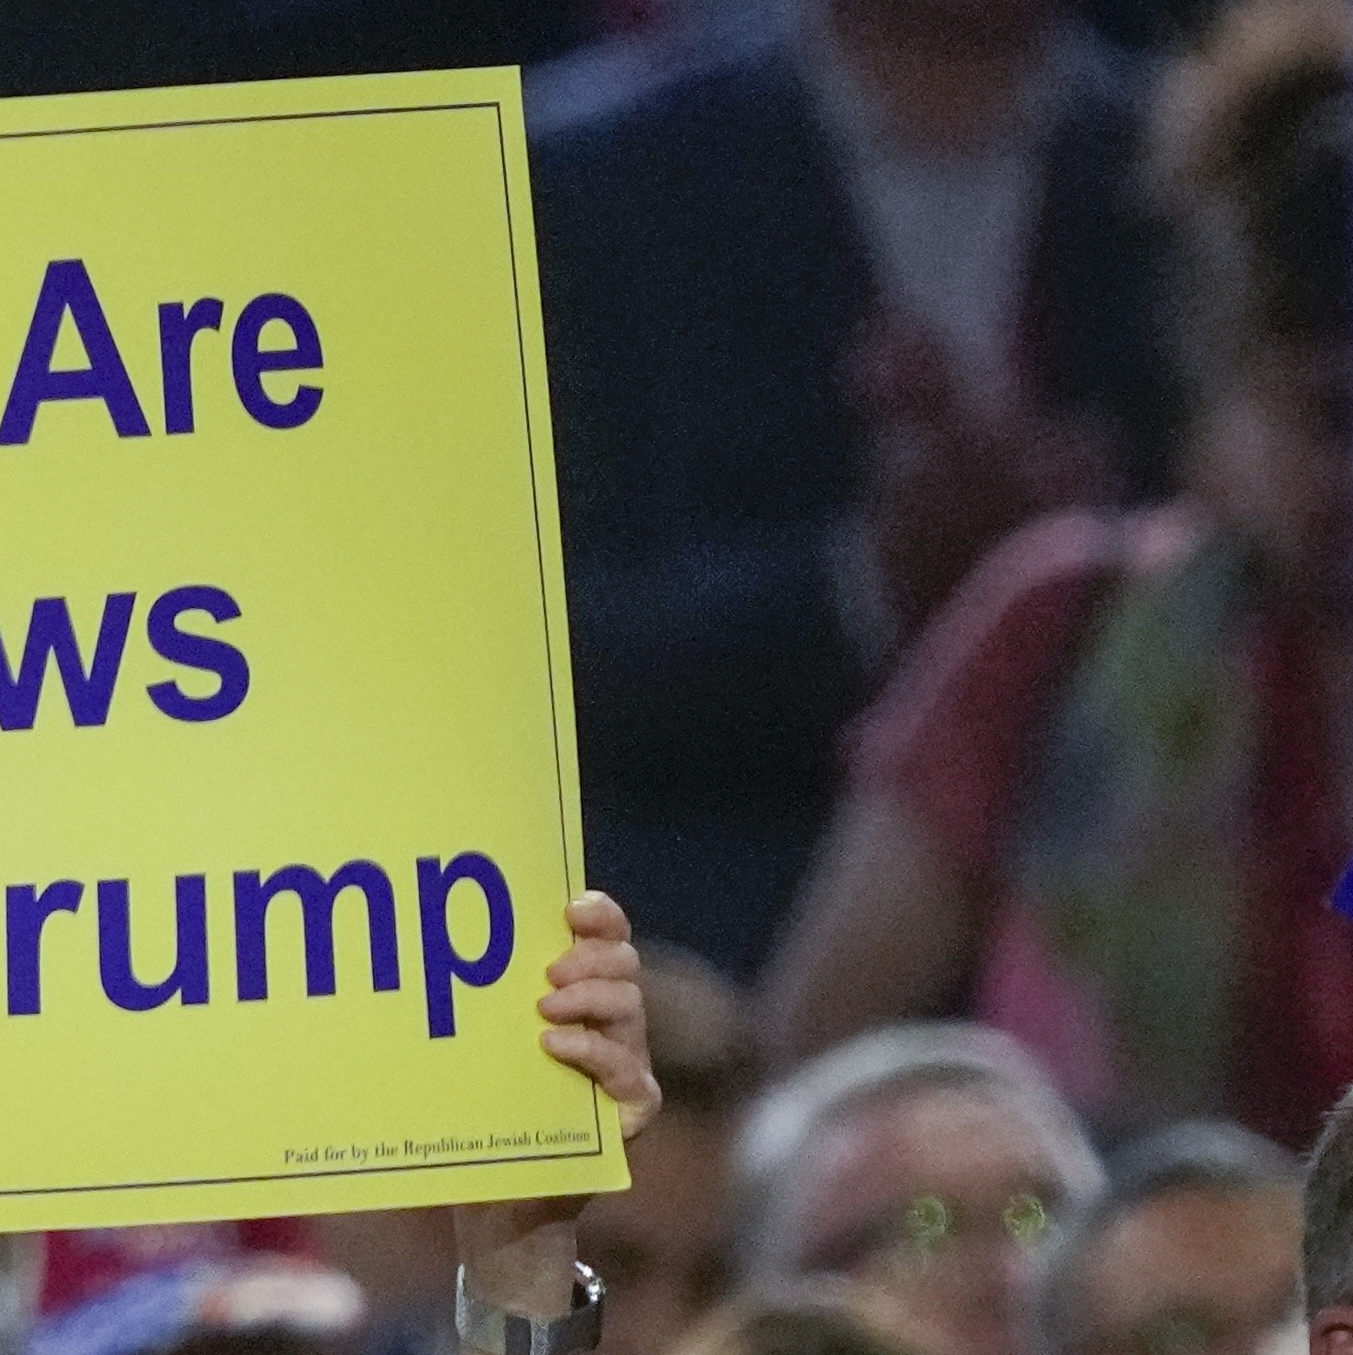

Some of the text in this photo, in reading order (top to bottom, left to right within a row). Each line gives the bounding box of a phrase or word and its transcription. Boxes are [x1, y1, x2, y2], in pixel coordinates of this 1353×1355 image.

[285, 1129, 590, 1165] Paid for by the Republican Jewish Coalition
